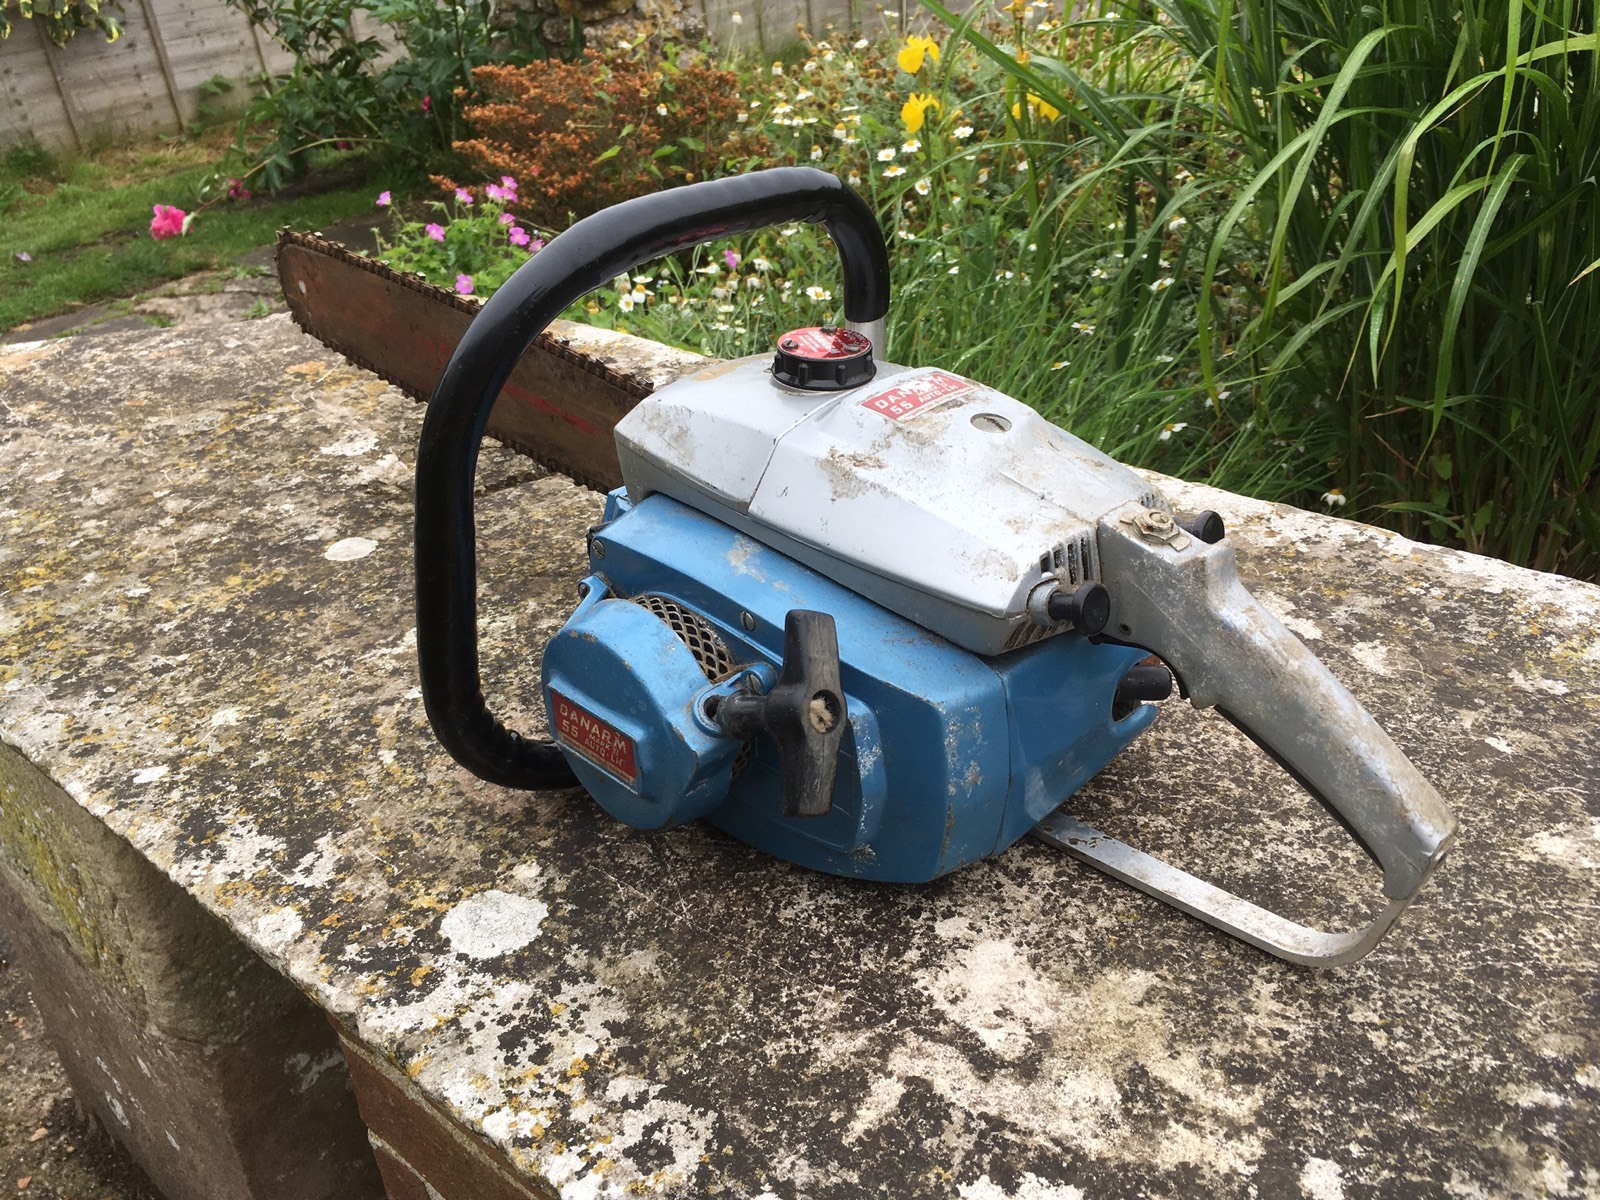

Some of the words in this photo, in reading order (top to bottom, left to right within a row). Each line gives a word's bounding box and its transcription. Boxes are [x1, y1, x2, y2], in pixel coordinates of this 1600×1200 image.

[890, 400, 913, 415] 55
[560, 702, 627, 755] DANARM
[562, 719, 579, 738] 55
[588, 733, 611, 751] MARK
